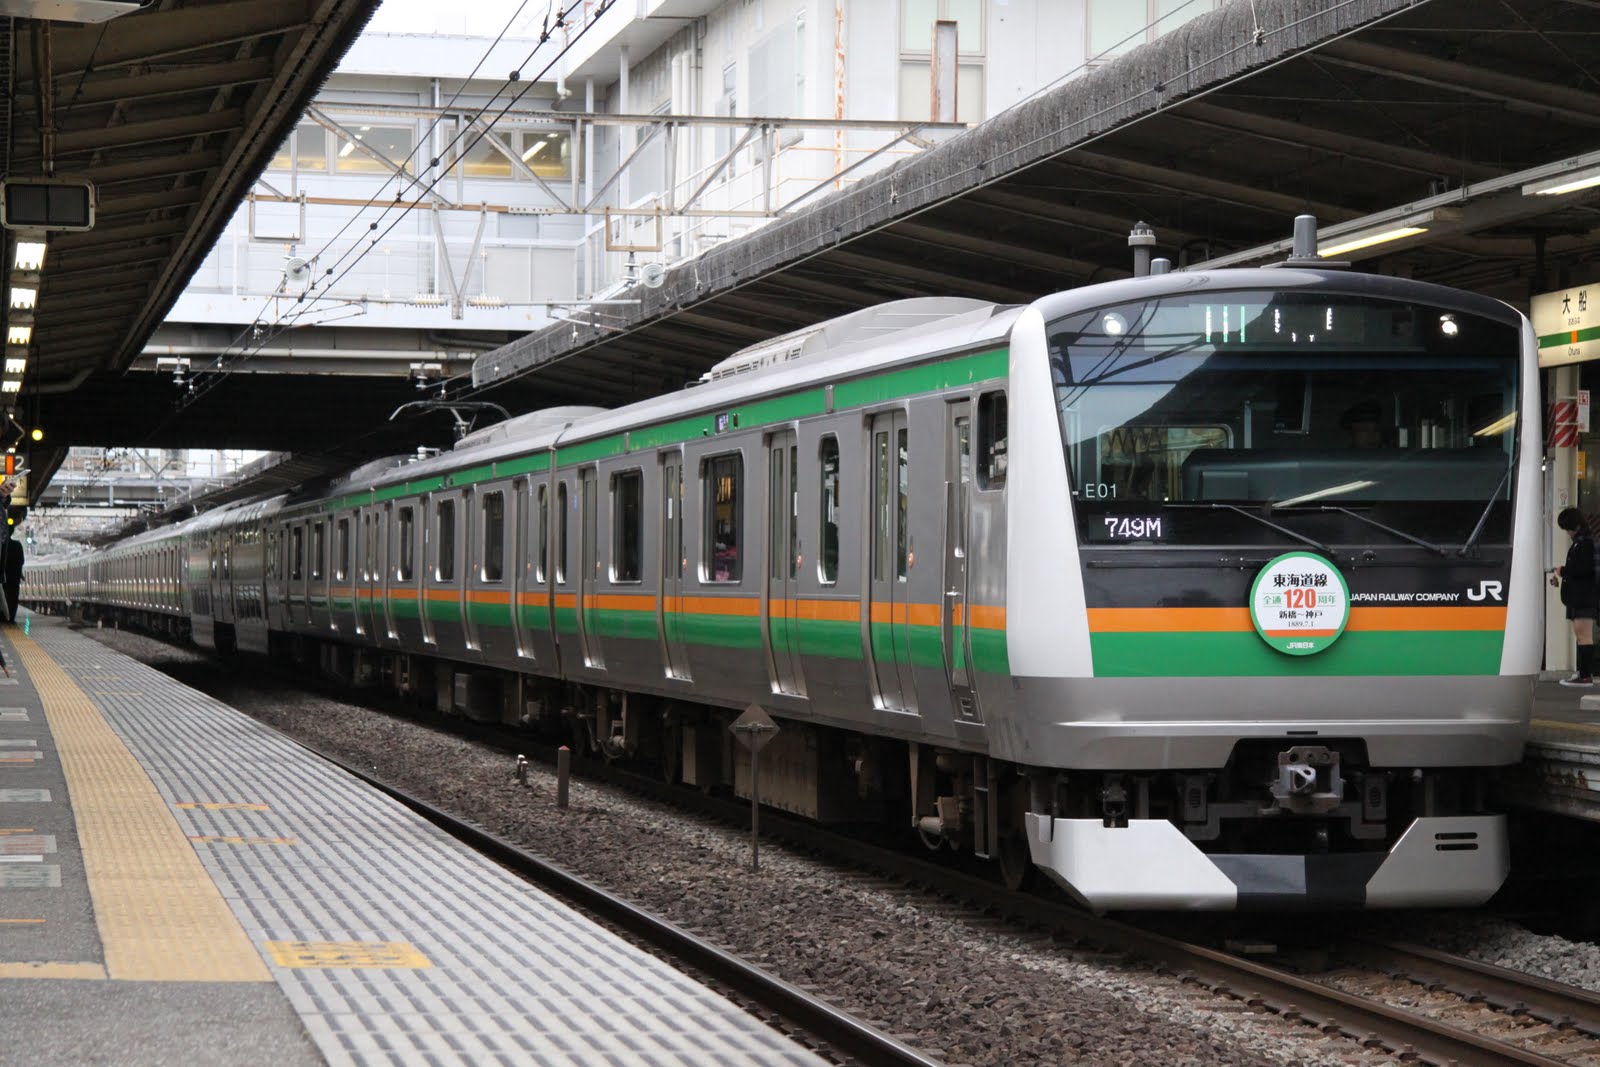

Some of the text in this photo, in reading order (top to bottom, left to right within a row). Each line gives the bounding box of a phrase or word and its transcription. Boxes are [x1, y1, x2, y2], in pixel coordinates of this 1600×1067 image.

[1562, 290, 1587, 315] 大船
[15, 455, 24, 470] 2
[1085, 483, 1117, 499] E01
[1104, 517, 1161, 538] 749M
[1273, 573, 1328, 588] 東海道線
[1350, 593, 1460, 601] JAPAN RAILWAY COMPANY
[1467, 580, 1503, 601] JR
